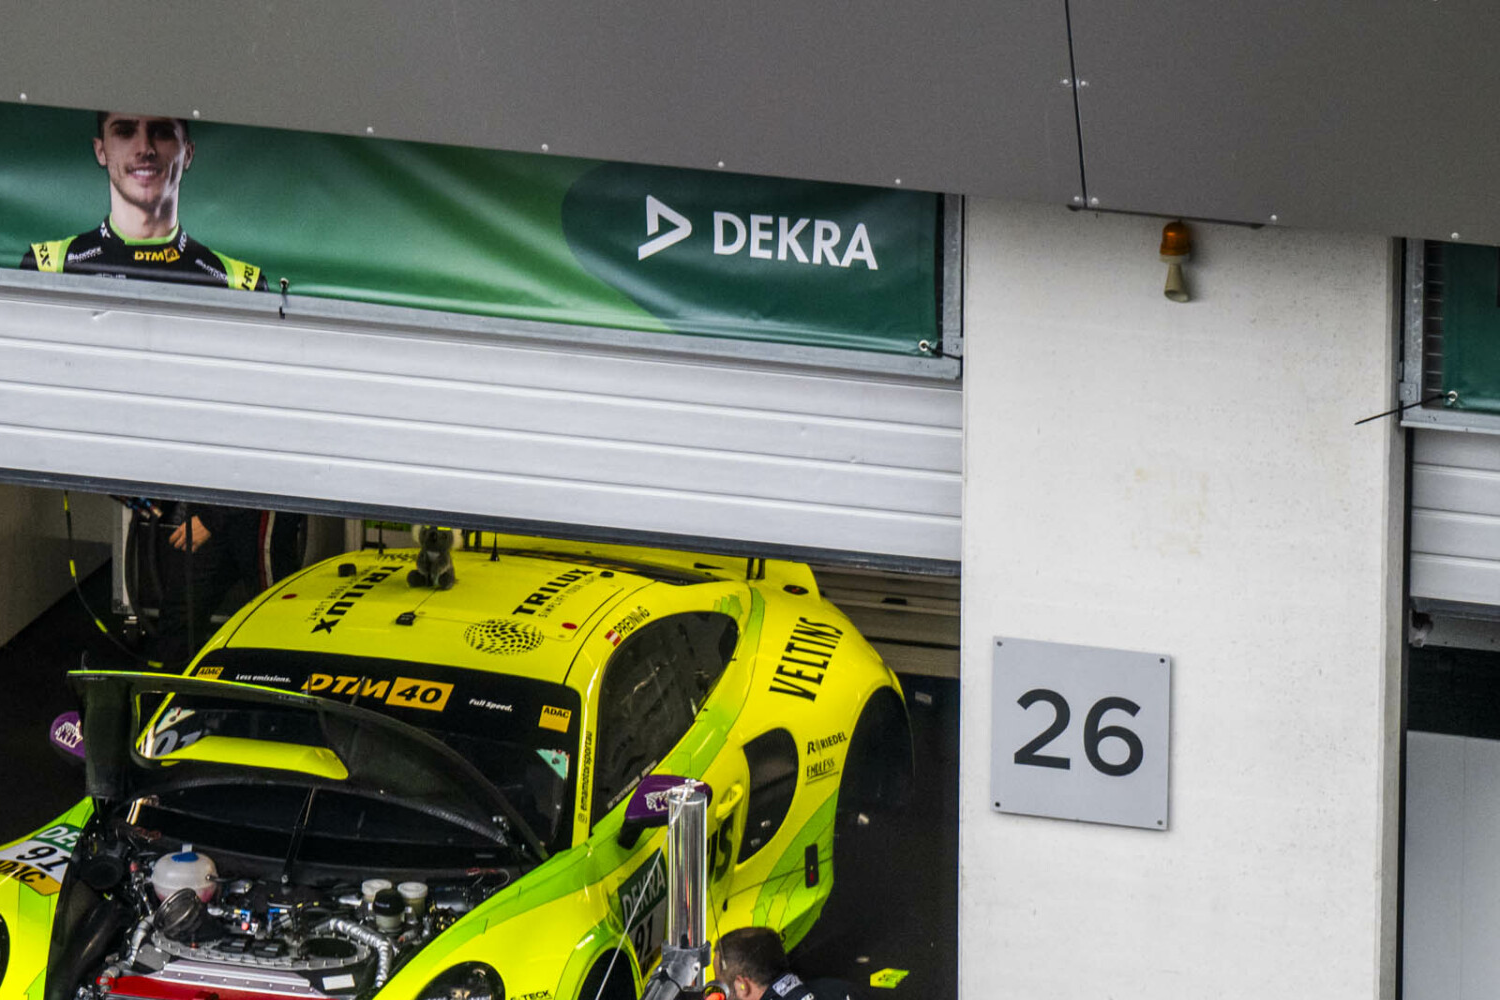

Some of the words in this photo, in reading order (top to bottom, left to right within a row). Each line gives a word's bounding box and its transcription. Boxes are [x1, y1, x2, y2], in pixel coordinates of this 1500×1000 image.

[713, 211, 879, 270] DEKRA
[512, 568, 594, 616] TRILUX
[612, 604, 651, 638] PREINING
[769, 616, 844, 702] VELTINS
[301, 673, 391, 700] DTM
[397, 684, 444, 705] 40
[543, 706, 571, 719] ADAC
[820, 731, 848, 751] RIEDEL
[1014, 688, 1144, 777] 26
[16, 846, 71, 872] 91
